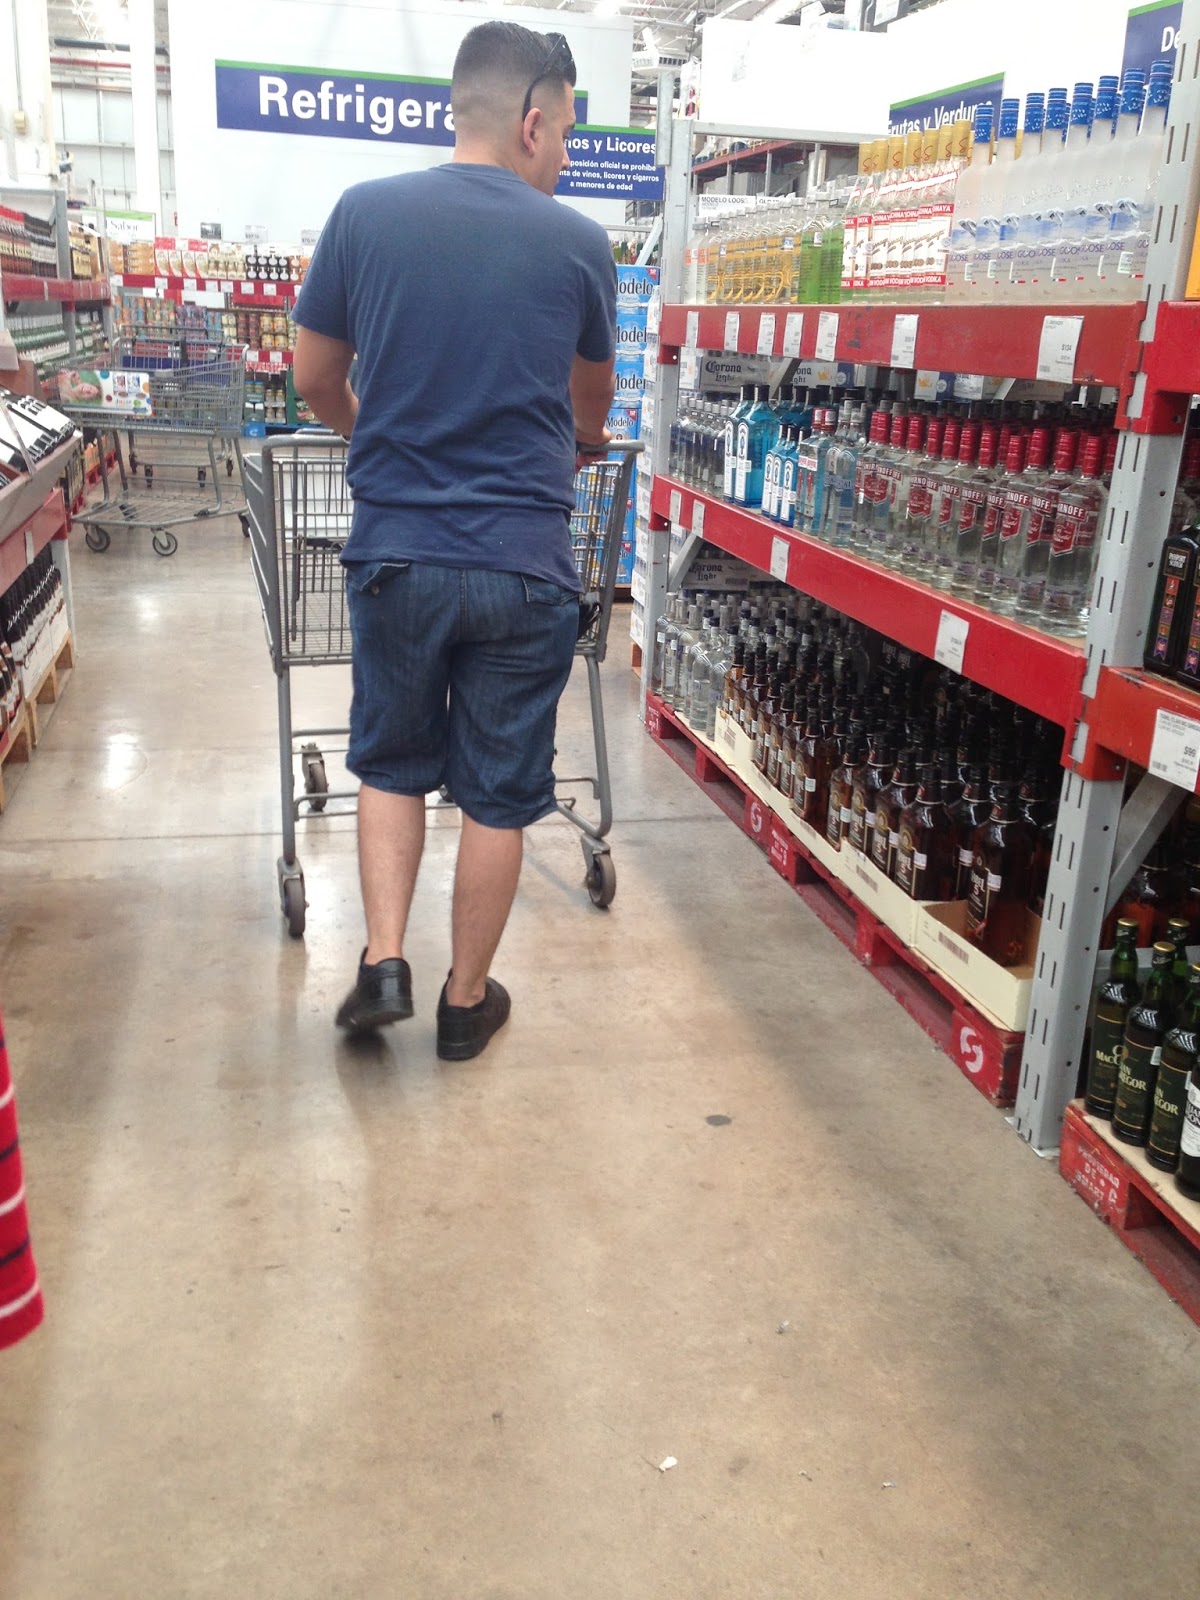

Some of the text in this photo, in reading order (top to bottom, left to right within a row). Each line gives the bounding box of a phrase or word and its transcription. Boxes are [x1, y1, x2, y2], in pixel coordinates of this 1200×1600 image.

[934, 100, 992, 131] Verdur
[564, 136, 656, 154] nos y Licores
[570, 160, 599, 169] posición
[600, 161, 620, 169] oficial
[572, 169, 581, 177] de
[603, 172, 626, 180] licores
[632, 174, 660, 182] cigarros
[575, 181, 605, 189] menores
[616, 183, 633, 191] edad
[615, 277, 654, 295] odelo
[616, 325, 647, 344] odel
[705, 360, 742, 373] Corona
[796, 366, 812, 375] ona
[615, 372, 646, 390] odel
[606, 417, 634, 428] Modelo
[1085, 1162, 1097, 1179] DE
